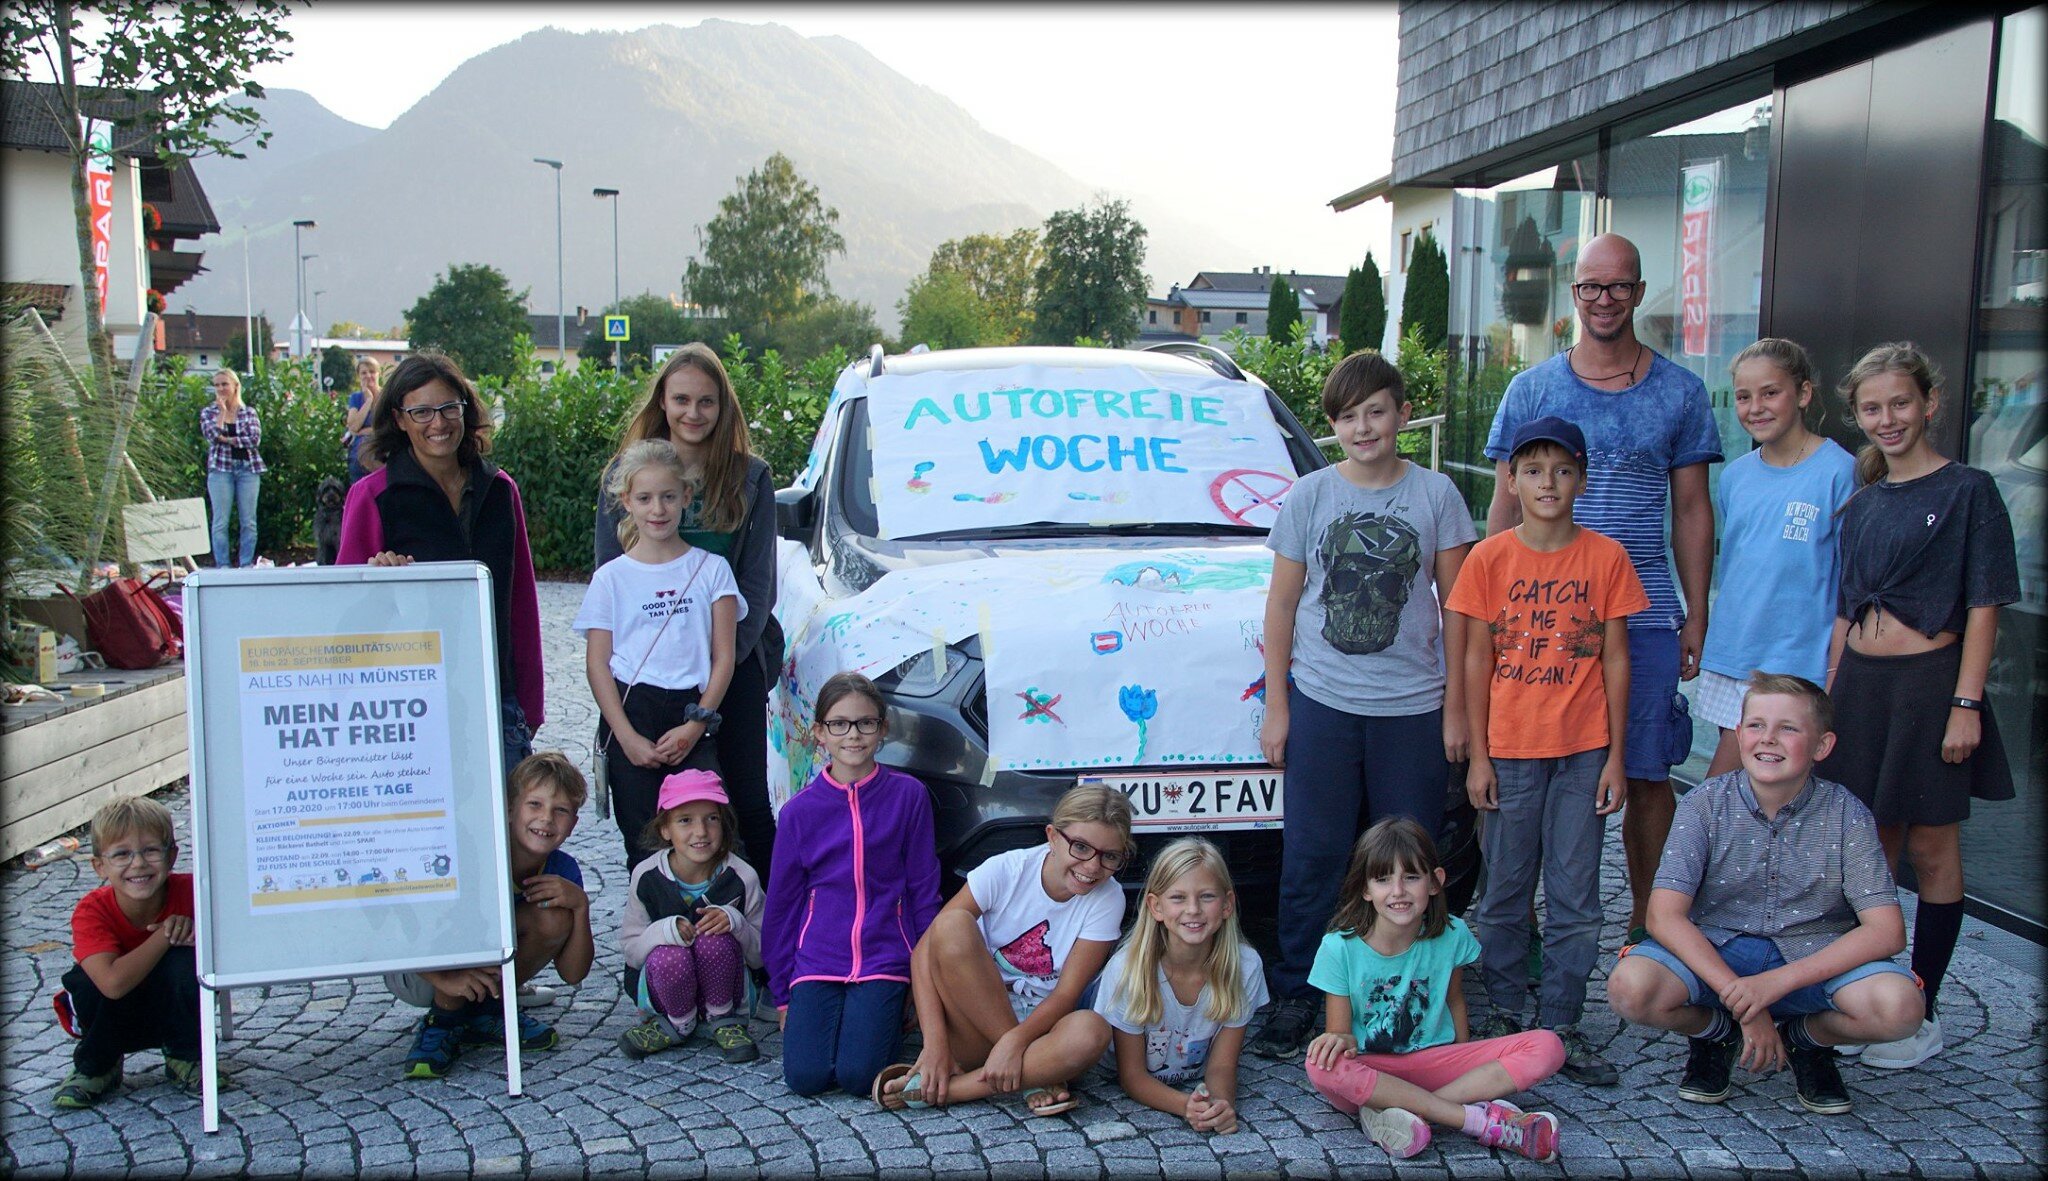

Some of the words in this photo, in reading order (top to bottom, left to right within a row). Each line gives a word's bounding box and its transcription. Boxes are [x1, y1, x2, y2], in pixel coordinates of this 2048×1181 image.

[903, 386, 1228, 430] AUTOFREIE
[978, 433, 1189, 474] WOCHE
[1784, 501, 1820, 522] NEWPORT
[1782, 524, 1810, 541] BEACH
[1508, 578, 1589, 605] CATCH
[642, 601, 666, 611] GOOD
[649, 610, 665, 618] TAN
[666, 606, 690, 616] LNES
[1121, 618, 1202, 642] WOCHE
[1530, 609, 1557, 631] ME
[1529, 637, 1550, 660] IF
[293, 655, 352, 666] SEPTEMBER
[249, 674, 293, 690] ALLES
[298, 673, 333, 687] NAH
[338, 672, 354, 685] IN
[360, 667, 438, 684] MÜNSTER
[264, 702, 339, 726] MEIN
[348, 698, 428, 721] AUTO
[279, 726, 340, 750] HAT
[350, 722, 416, 746] FREI!
[283, 757, 313, 768] Unser
[316, 753, 388, 767] Bürgermeister
[391, 751, 414, 761] lässt
[264, 775, 282, 788] für
[285, 774, 309, 785] eine
[311, 772, 345, 783] Woche
[346, 770, 368, 781] sein
[370, 769, 395, 780] Auto
[397, 766, 431, 778] stehen!
[287, 785, 369, 802] AUTOFREIE
[374, 783, 413, 796] TAGE
[1120, 781, 1161, 816] KU
[254, 808, 271, 816] Start
[272, 803, 323, 815] 17.09.2020
[337, 800, 362, 811] 17:00
[363, 799, 380, 808] Uhr
[257, 820, 296, 831] AKTIONEN
[1166, 823, 1219, 832] www.autopark.at
[257, 854, 300, 864] INFOSTAND
[269, 862, 288, 870] FUSS
[313, 859, 341, 867] SCHULE
